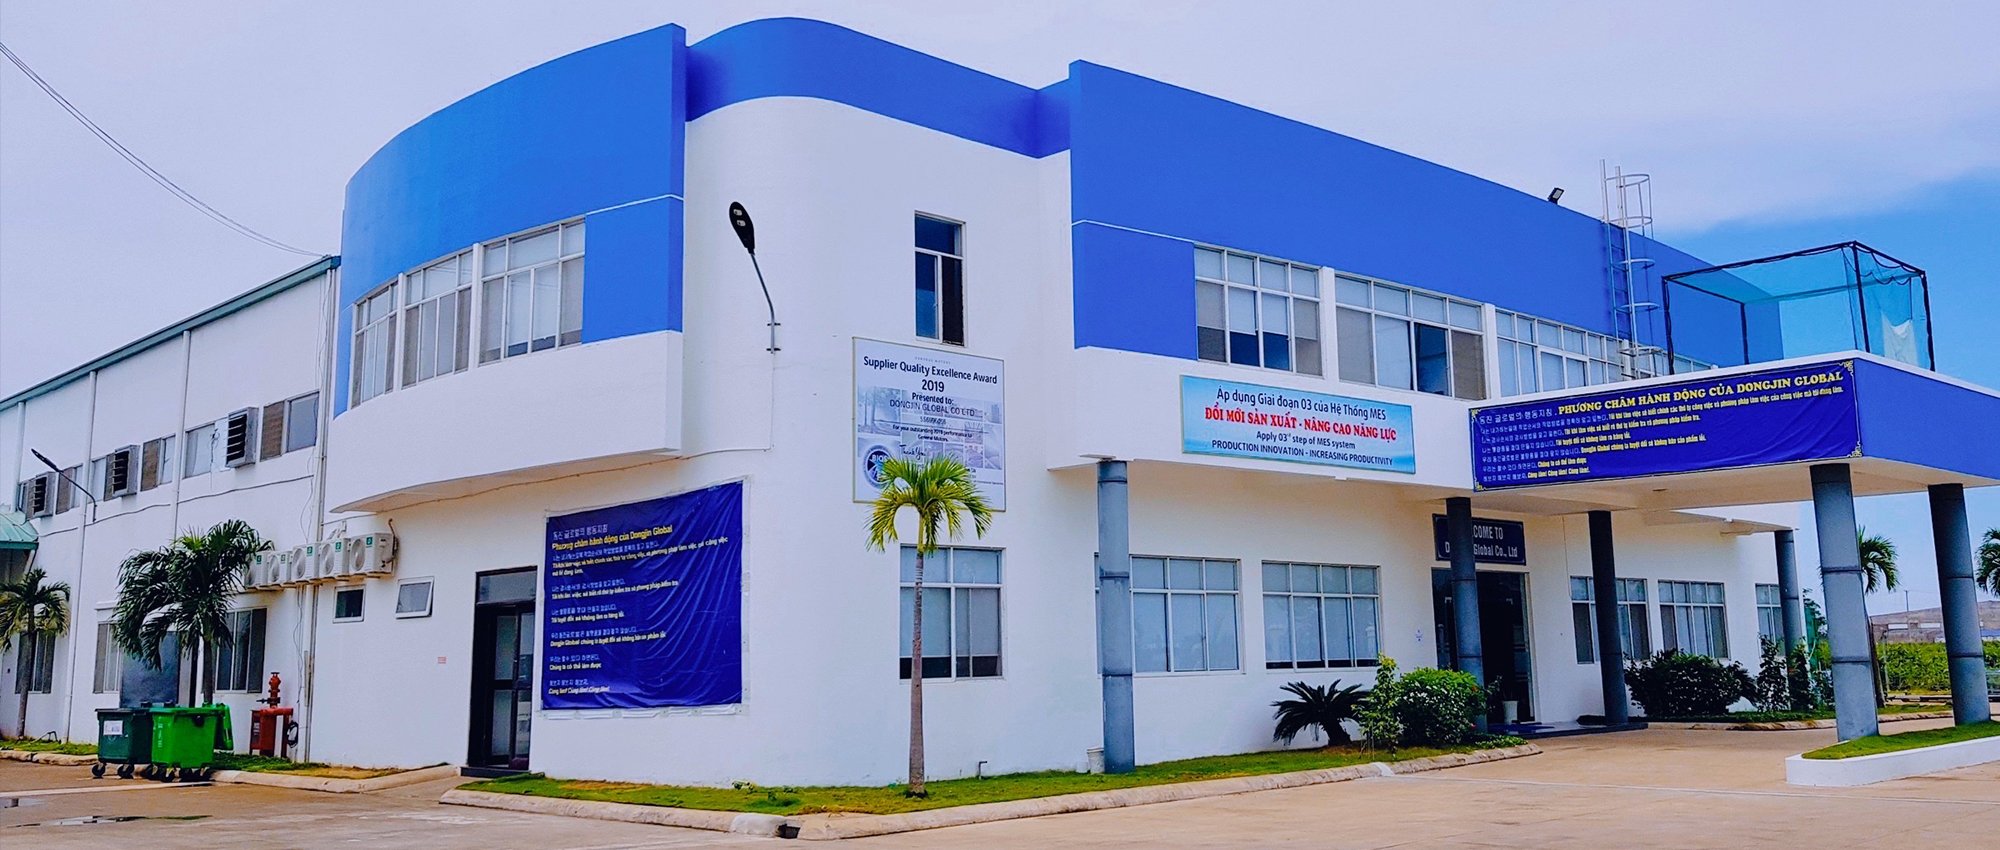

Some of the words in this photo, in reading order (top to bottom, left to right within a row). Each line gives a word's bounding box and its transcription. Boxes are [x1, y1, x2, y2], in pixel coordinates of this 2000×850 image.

[864, 356, 898, 370] Supplier
[900, 362, 930, 376] Quality
[932, 366, 971, 380] Excellence
[973, 372, 997, 384] Award
[922, 380, 944, 392] 2019
[1558, 402, 1602, 414] PHƯƠNG
[1638, 393, 1670, 405] HÀNH
[1674, 389, 1706, 401] ĐỘNG
[1709, 383, 1734, 396] CỦA
[1737, 378, 1791, 393] DONGJIN
[1794, 372, 1843, 386] GLOBAL
[890, 400, 920, 410] DONGJIN
[922, 404, 948, 414] GLOBAL
[912, 392, 944, 404] Presented
[945, 396, 954, 405] to:
[1216, 386, 1230, 404] Áp
[1232, 390, 1256, 406] dụng
[1258, 393, 1275, 405] Giai
[1277, 395, 1299, 410] đoạn
[1301, 398, 1312, 410] 03
[1314, 401, 1328, 412] của
[1330, 403, 1341, 416] Hệ
[1370, 408, 1386, 420] MES
[1205, 402, 1224, 420] ĐỔI
[1226, 408, 1245, 423] MỚI
[1248, 408, 1268, 425] SẢN
[1270, 412, 1297, 428] XUẤT
[1304, 417, 1330, 432] NÂNG
[1333, 423, 1351, 435] CAO
[1353, 423, 1378, 438] NĂNG
[1380, 427, 1396, 443] LỰC
[1256, 431, 1277, 442] Apply
[1292, 435, 1307, 445] step
[1309, 436, 1315, 444] of
[1317, 438, 1330, 446] MES
[1332, 441, 1355, 449] system
[1212, 440, 1259, 451] PRODUCTION
[1260, 446, 1304, 456] INNOVATION
[1310, 450, 1348, 461] INCREASING
[1349, 454, 1392, 465] PRODUCTIVITY
[630, 529, 652, 540] Dongjin
[653, 524, 672, 535] Global
[1473, 525, 1493, 539] COME
[1495, 527, 1503, 539] TO
[1473, 544, 1493, 556] Global
[1508, 546, 1518, 557] Ltd
